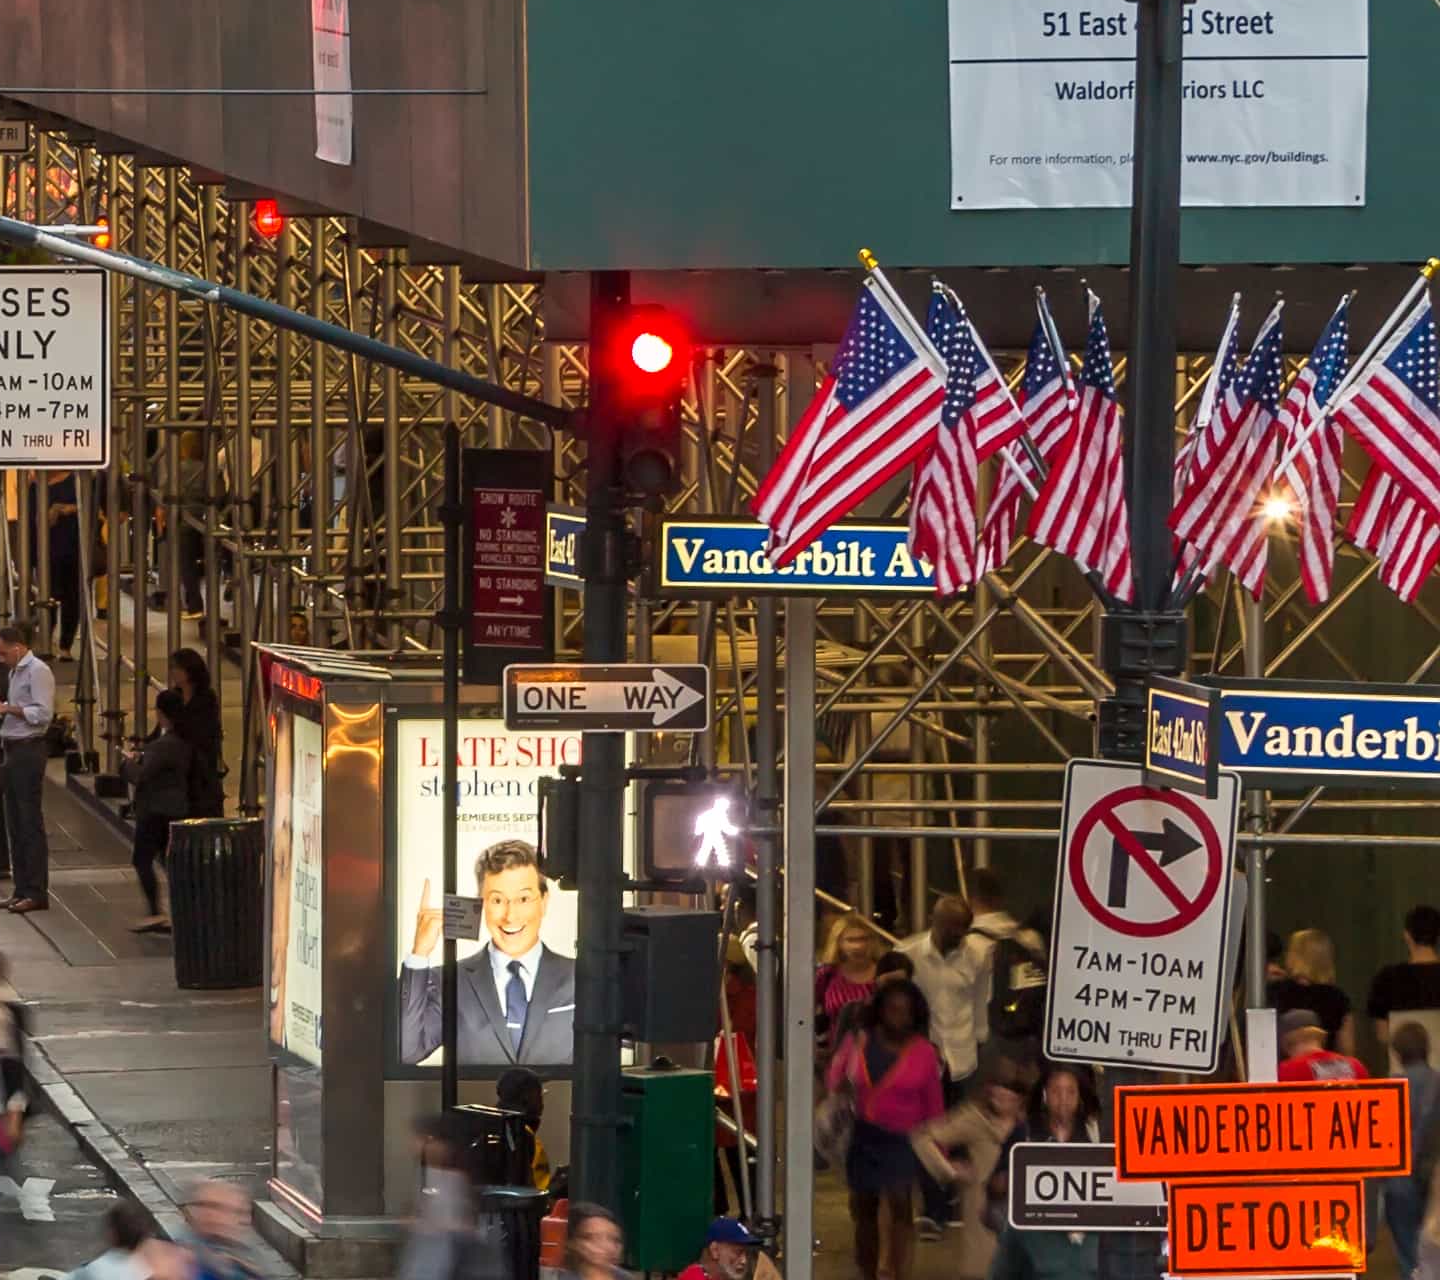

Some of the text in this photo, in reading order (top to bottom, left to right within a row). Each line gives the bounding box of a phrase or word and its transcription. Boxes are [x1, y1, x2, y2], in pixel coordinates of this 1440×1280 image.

[1042, 11, 1071, 37] 51
[1078, 11, 1128, 36] East
[1200, 8, 1274, 35] Street
[1054, 78, 1265, 102] Waldorf LLC
[0, 128, 19, 140] FRI
[989, 153, 1009, 166] For
[1011, 155, 1041, 166] more
[1044, 151, 1116, 167] information,
[1185, 151, 1330, 167] www.nyc.gov/buildings.
[22, 435, 54, 448] THRU
[62, 429, 91, 448] FRI
[480, 492, 537, 507] SNOW ROUTE
[479, 528, 537, 543] NO STANDING
[479, 577, 537, 591] NO STANDING
[486, 624, 531, 639] ANYTIME
[523, 686, 685, 711] ONE WAY
[1151, 709, 1172, 758] East
[1172, 716, 1195, 764] 42nd
[420, 769, 521, 808] stphen
[1073, 945, 1205, 980] 7AM-10AM
[1074, 983, 1196, 1016] 4PM-7PM
[1056, 1016, 1208, 1053] MON THRU FRI
[1132, 1099, 1394, 1156] VANDERBILT AVE.
[1034, 1171, 1114, 1202] ONE
[1185, 1198, 1352, 1253] DETOUR
